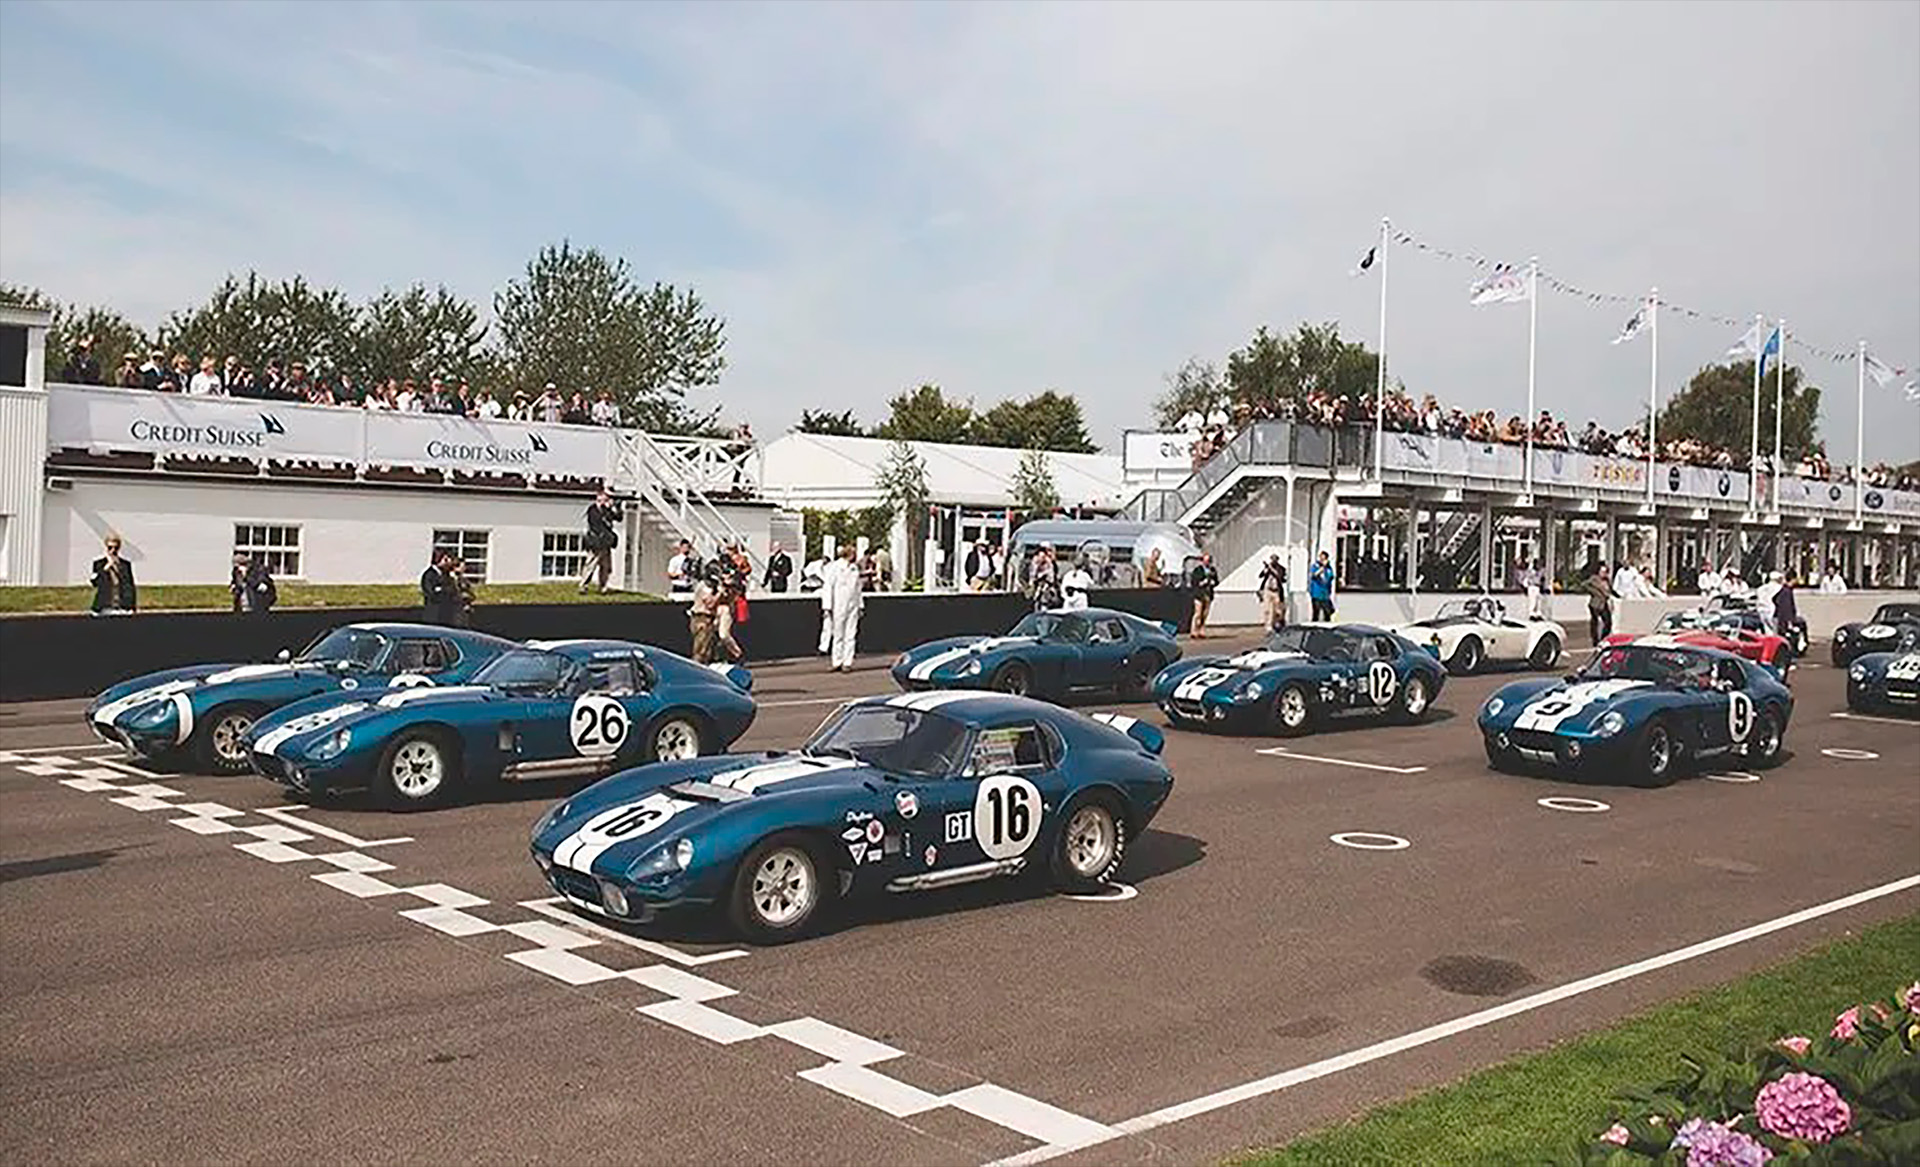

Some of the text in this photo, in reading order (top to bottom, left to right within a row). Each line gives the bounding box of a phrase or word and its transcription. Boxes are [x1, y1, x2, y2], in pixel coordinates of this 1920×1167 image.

[130, 420, 265, 447] CREDIT SUISSE
[427, 440, 531, 463] CREDIT SUISSE
[1373, 667, 1392, 699] 12
[576, 703, 624, 746] 26
[1735, 696, 1747, 734] 9
[591, 805, 663, 838] 16
[948, 814, 969, 839] GT
[988, 785, 1029, 845] 16
